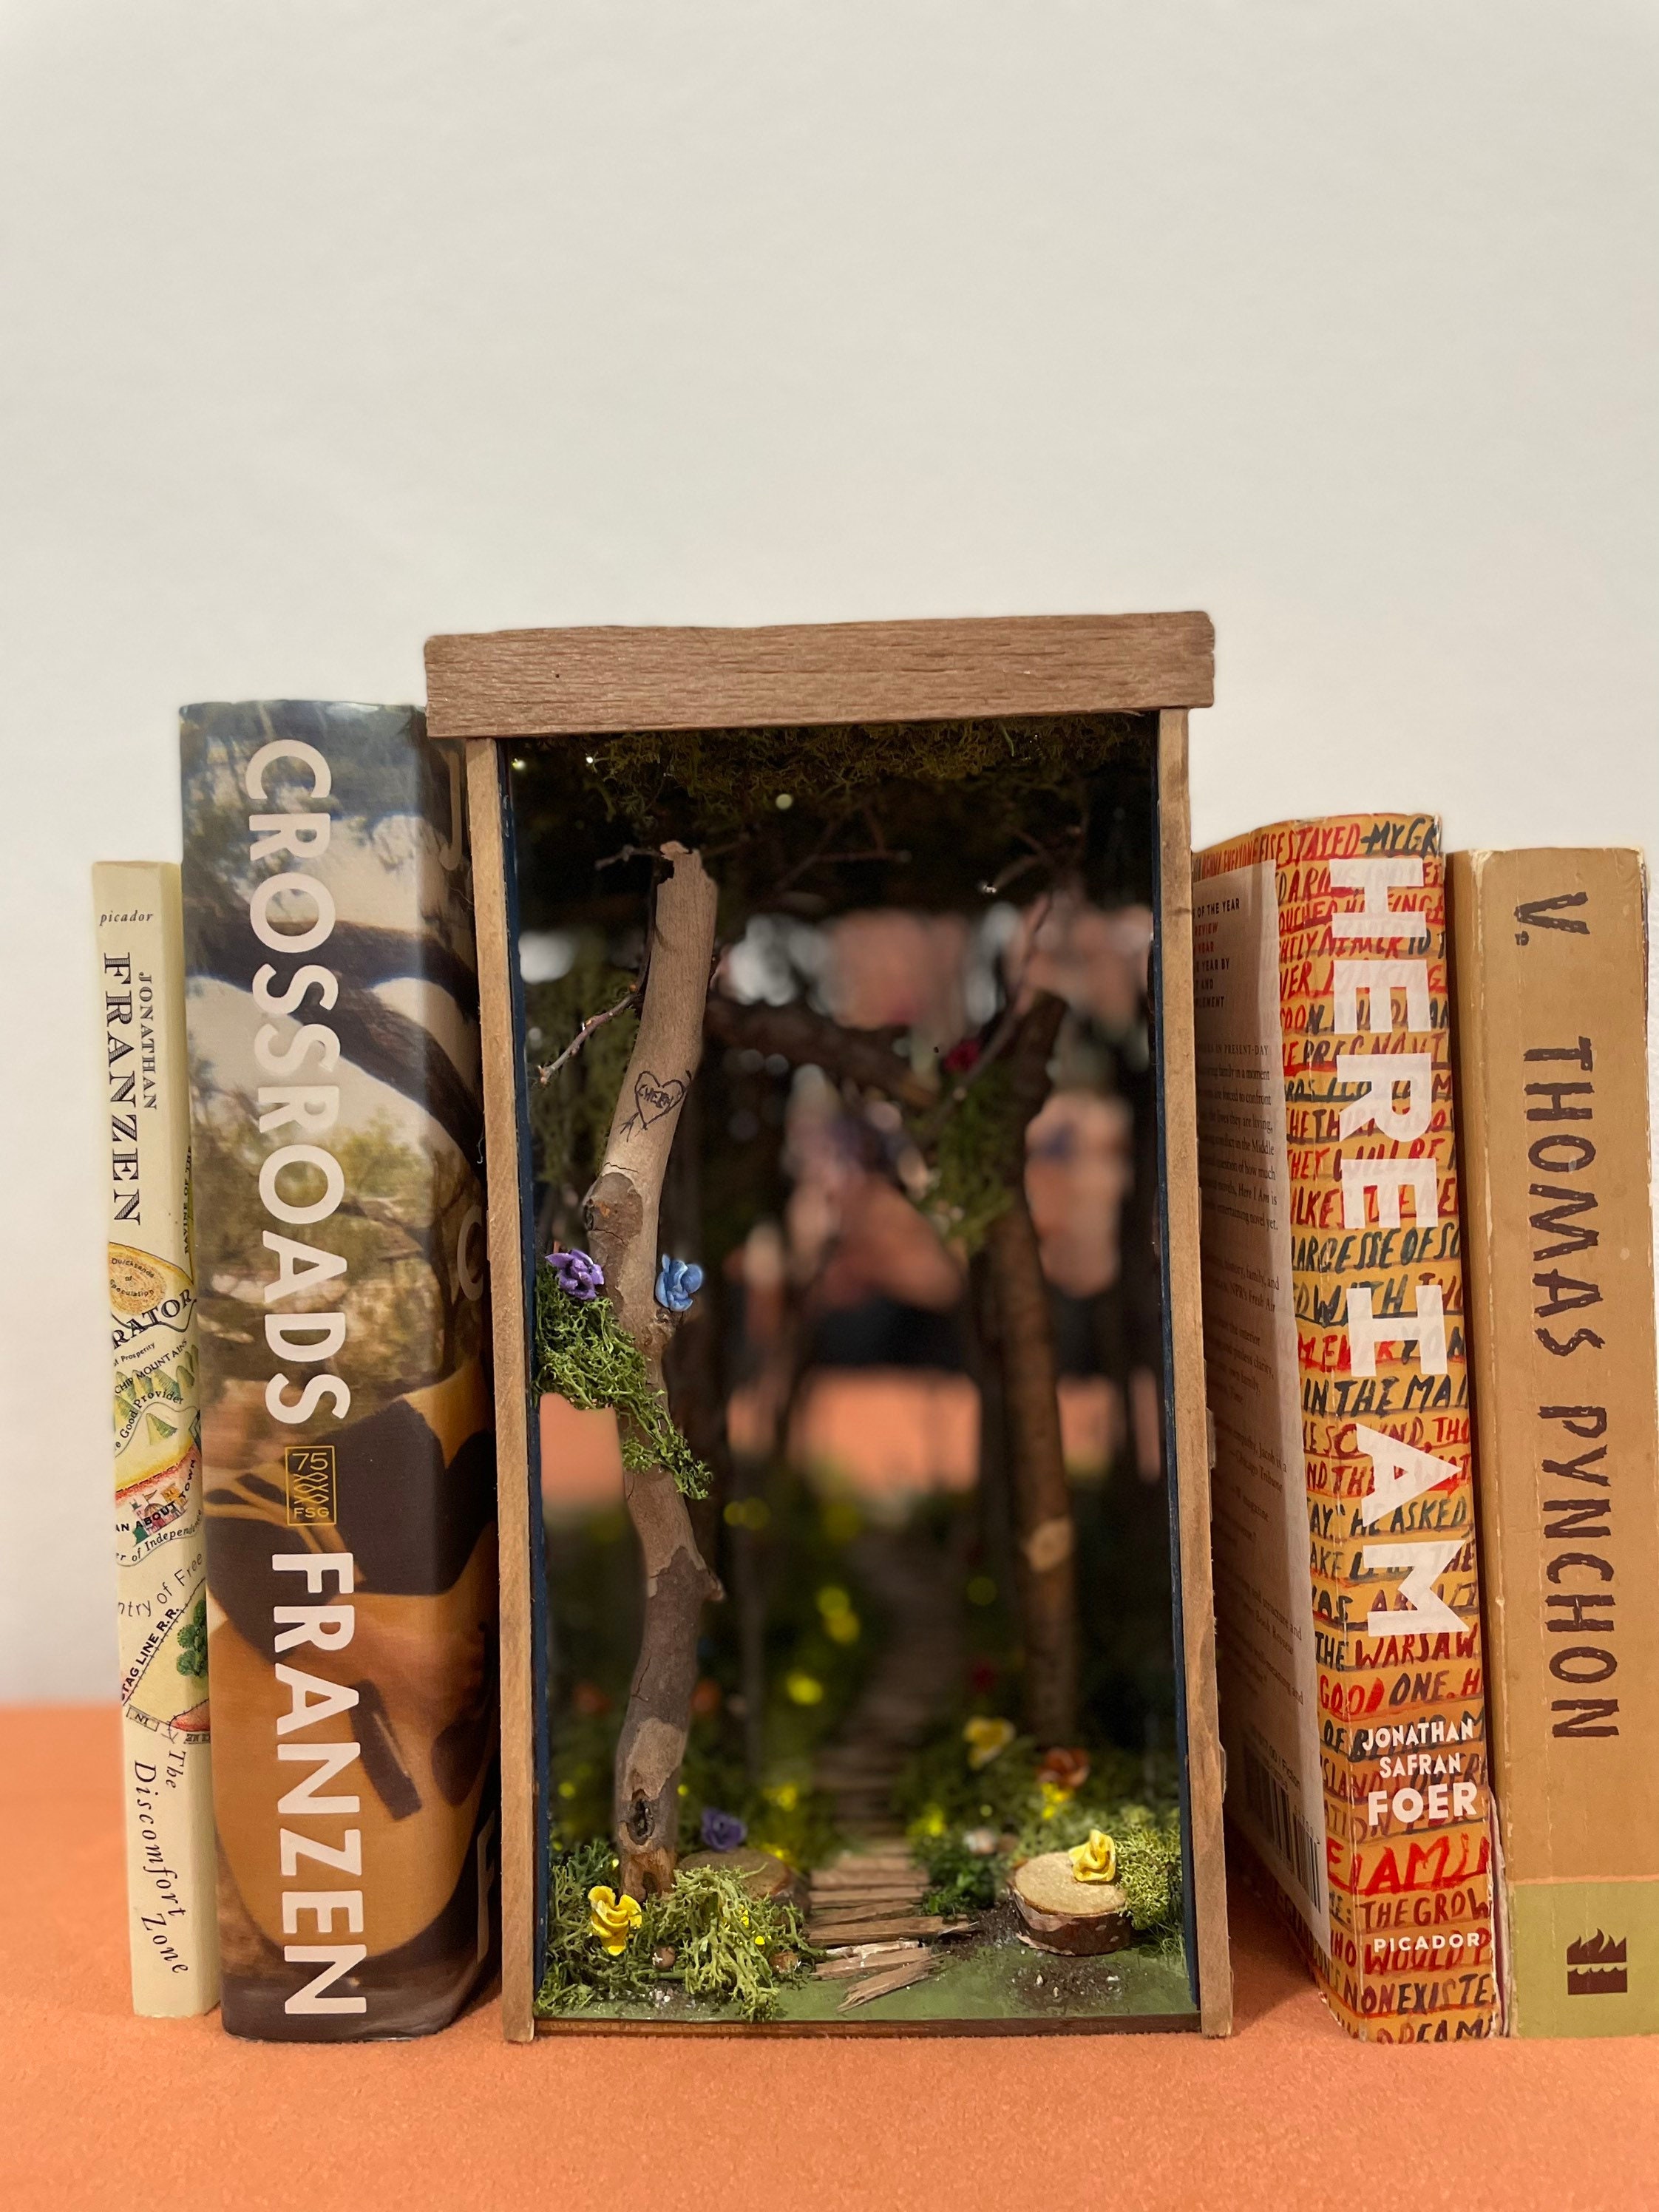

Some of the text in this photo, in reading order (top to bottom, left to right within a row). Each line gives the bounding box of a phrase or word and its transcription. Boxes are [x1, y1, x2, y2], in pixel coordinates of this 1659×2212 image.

[99, 910, 154, 926] picador
[1207, 902, 1219, 915] THE
[1222, 898, 1240, 913] YEAR
[1513, 892, 1590, 946] V.
[1202, 960, 1218, 972] YEAR
[138, 971, 157, 1110] JONATHAN
[1224, 1043, 1269, 1056] PRESENT-DAY
[1329, 858, 1439, 1229] HERE
[104, 952, 140, 1226] FRANZEN
[245, 739, 351, 1424] CROSSROADS
[1246, 1089, 1271, 1105] confront
[1252, 1114, 1273, 1133] living,
[1252, 1138, 1275, 1156] Middle
[1258, 1165, 1276, 1181] much
[1238, 1184, 1252, 1199] Here
[1258, 1187, 1269, 1204] Am
[1271, 1190, 1278, 1205] is
[1266, 1218, 1278, 1232] yet.
[112, 1258, 155, 1278] Quicksands
[110, 1279, 155, 1297] Speculation
[1267, 1276, 1280, 1291] and
[1346, 1284, 1448, 1377] I
[121, 1343, 155, 1363] Prosperity
[1334, 1376, 1400, 1421] THE
[1523, 1036, 1620, 1738] THOMAS PYNCHON
[120, 1389, 183, 1438] Good Provider
[292, 1452, 329, 1471] 75
[136, 1501, 177, 1530] ABOUT
[178, 1459, 195, 1499] TOWN
[294, 1507, 330, 1519] FSG
[1356, 1423, 1470, 1638] AM
[132, 1547, 140, 1562] of
[1290, 1623, 1302, 1641] and
[1314, 1631, 1349, 1672] THE
[1355, 1622, 1478, 1669] WARSAW
[135, 1633, 159, 1666] LINE
[1320, 1674, 1385, 1717] GOOD
[1362, 1718, 1474, 1751] JONATHAN
[166, 1750, 186, 1788] The
[1379, 1752, 1462, 1779] SAFRAN
[271, 1553, 367, 2015] FRANZEN
[1368, 1782, 1478, 1826] FOER
[135, 1760, 189, 1973] Discomfort Zone
[1354, 1898, 1408, 1935] THE
[1374, 1932, 1480, 1953] PICADOR
